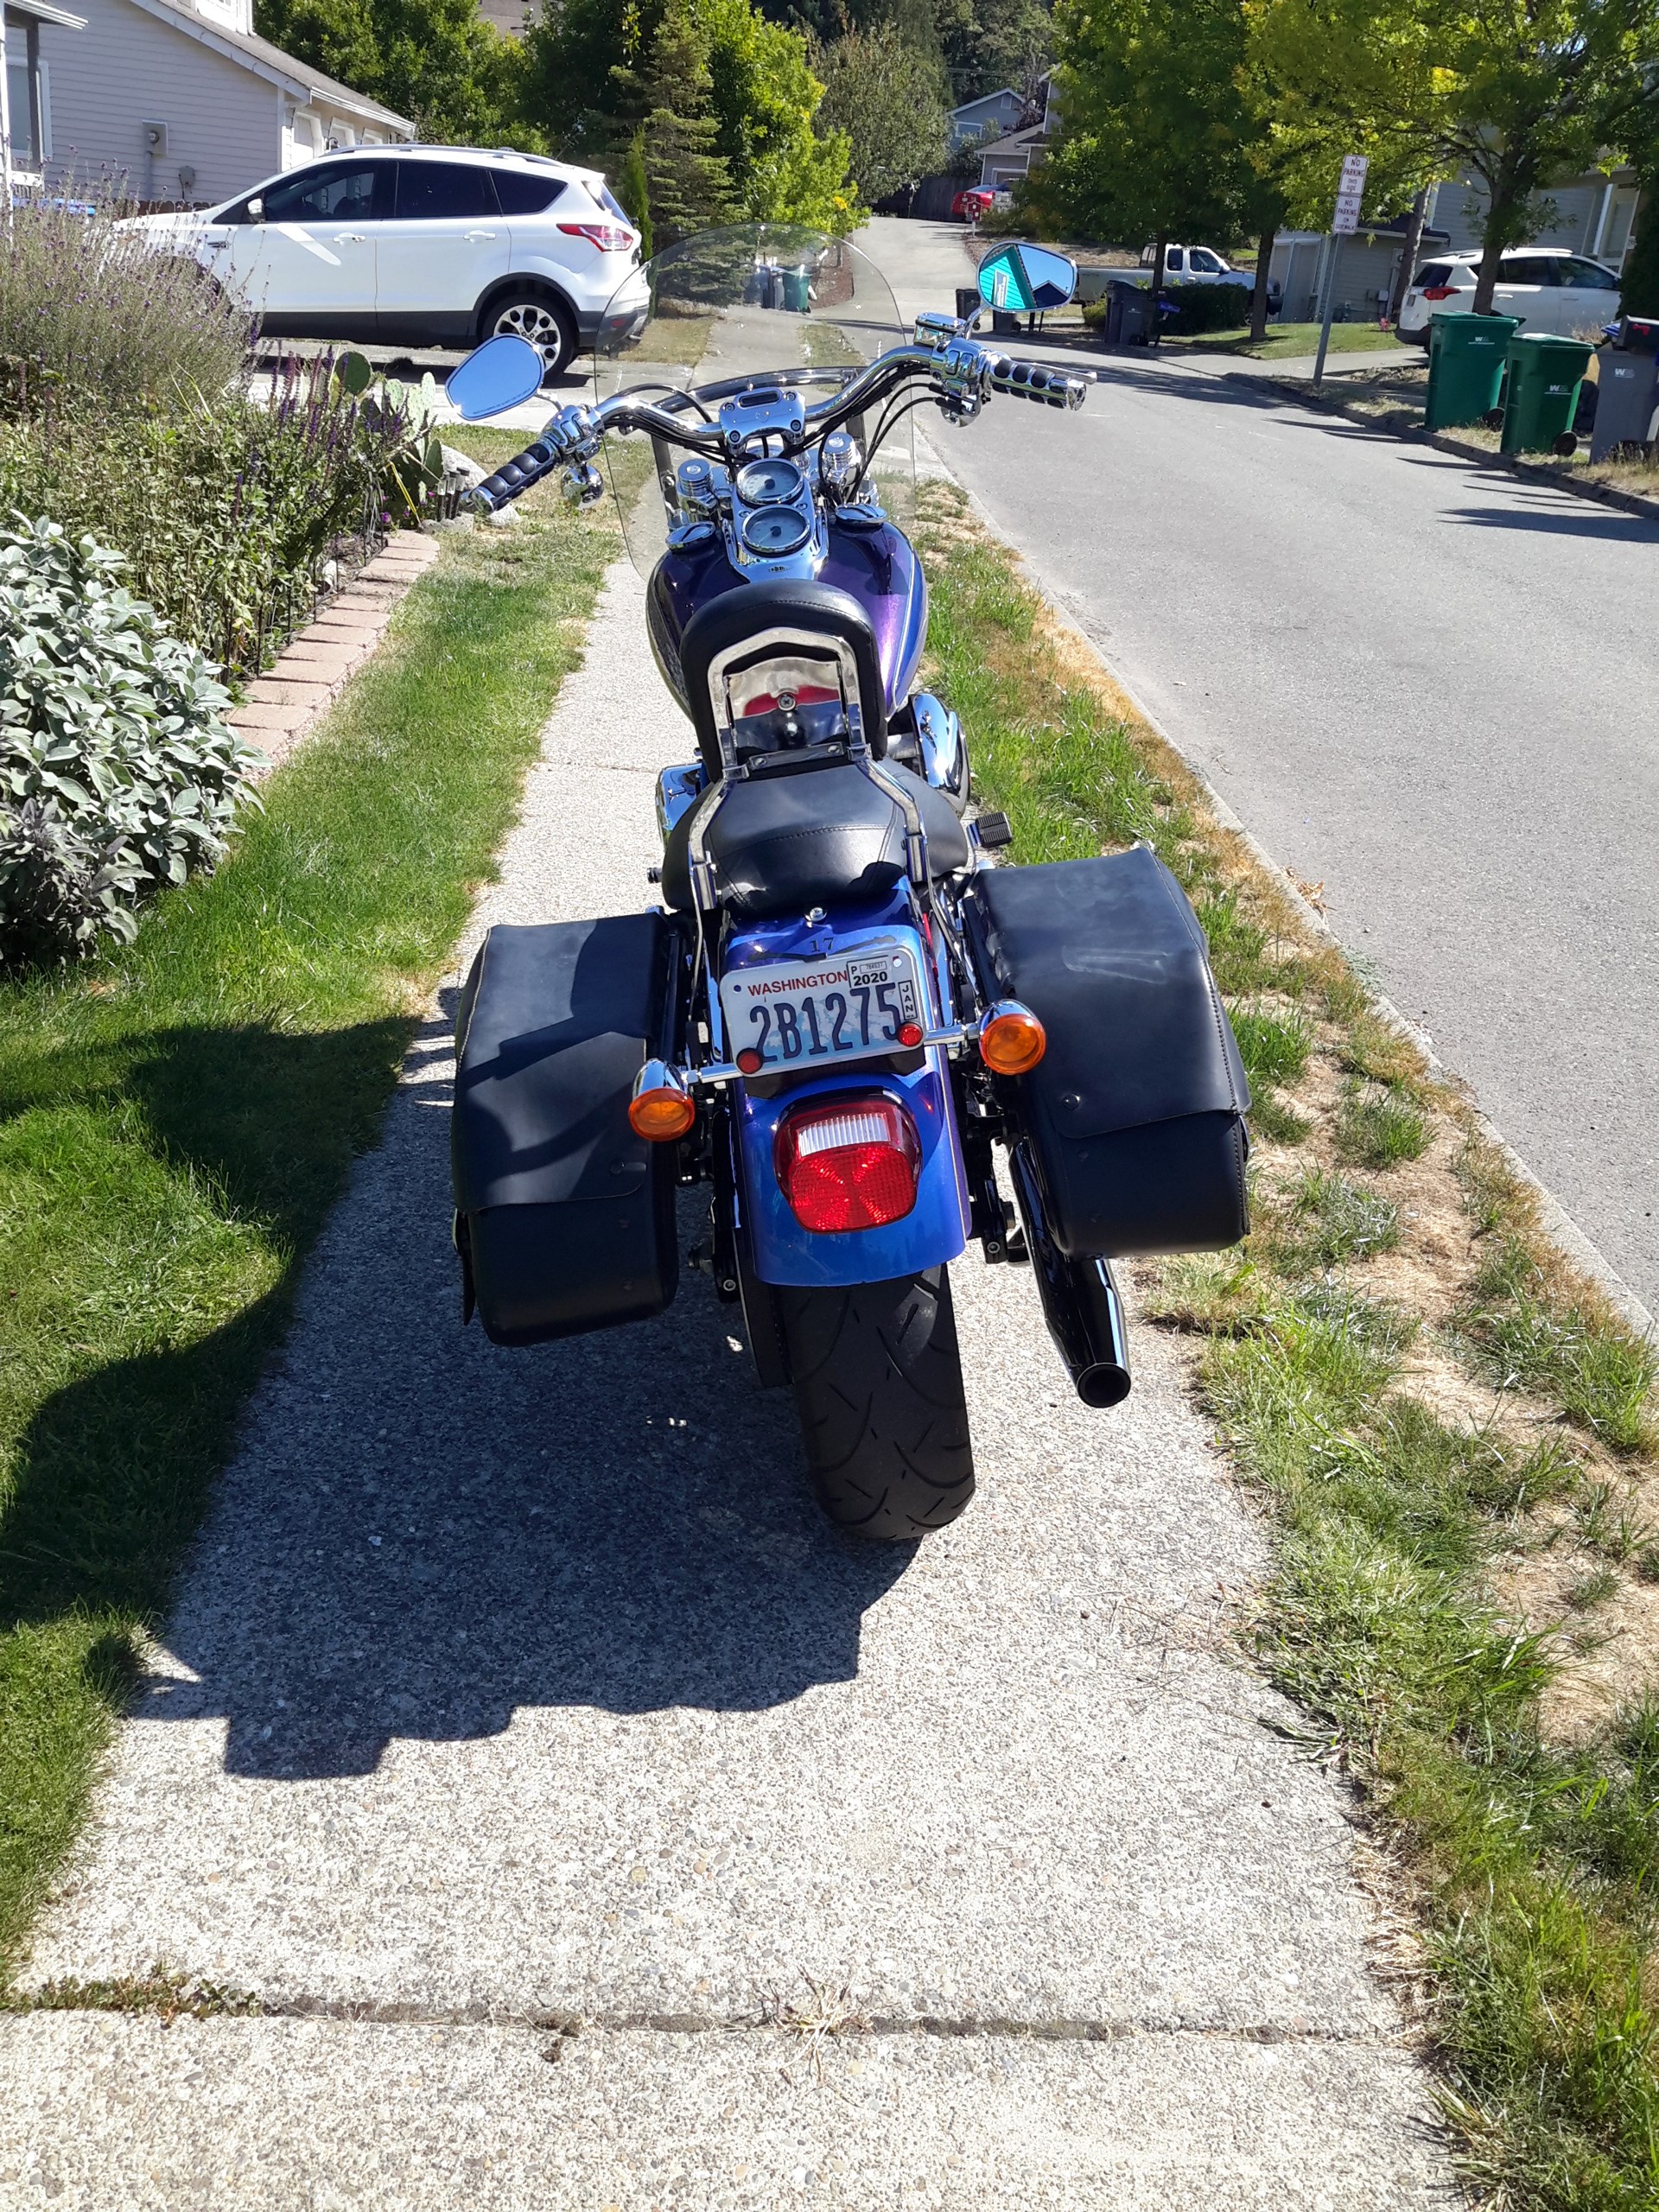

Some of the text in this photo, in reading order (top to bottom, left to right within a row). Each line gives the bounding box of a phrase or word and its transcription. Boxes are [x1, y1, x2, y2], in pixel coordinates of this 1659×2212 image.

[1344, 168, 1364, 177] PARKING
[809, 937, 835, 953] 17
[851, 966, 858, 975] P
[747, 969, 849, 997] WASHINGTON
[853, 971, 888, 987] 2020
[902, 984, 914, 1013] JAN
[749, 982, 902, 1063] 2B1275
